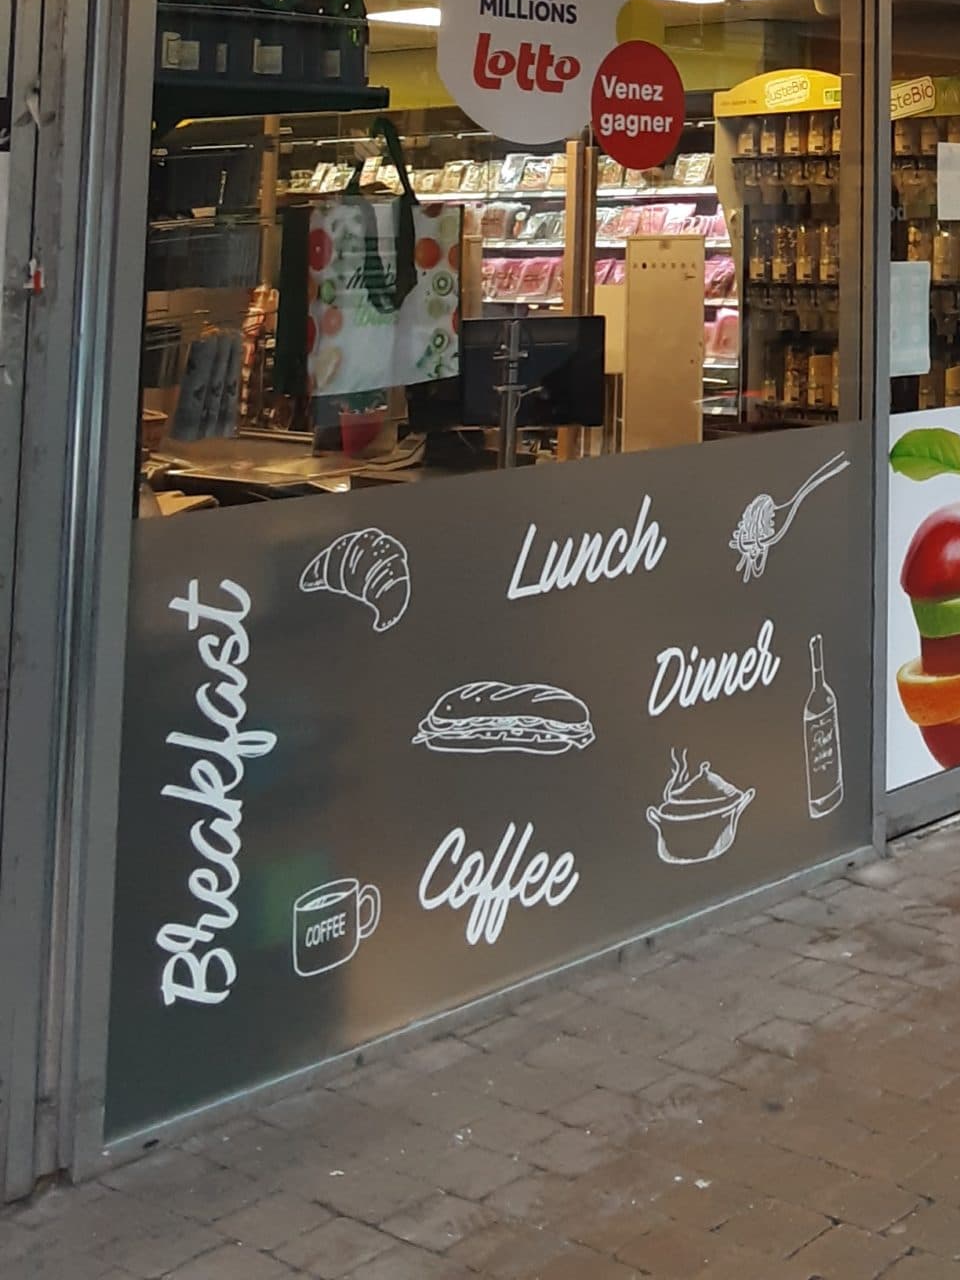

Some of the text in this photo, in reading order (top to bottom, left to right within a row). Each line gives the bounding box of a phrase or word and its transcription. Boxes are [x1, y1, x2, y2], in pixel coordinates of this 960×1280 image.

[600, 113, 673, 138] gagner
[601, 75, 664, 102] Venez
[506, 495, 668, 600] Lunch
[647, 618, 781, 718] Dinner
[160, 578, 277, 1006] Breakfast
[305, 913, 347, 945] COFFEE
[417, 821, 580, 944] Coffee
